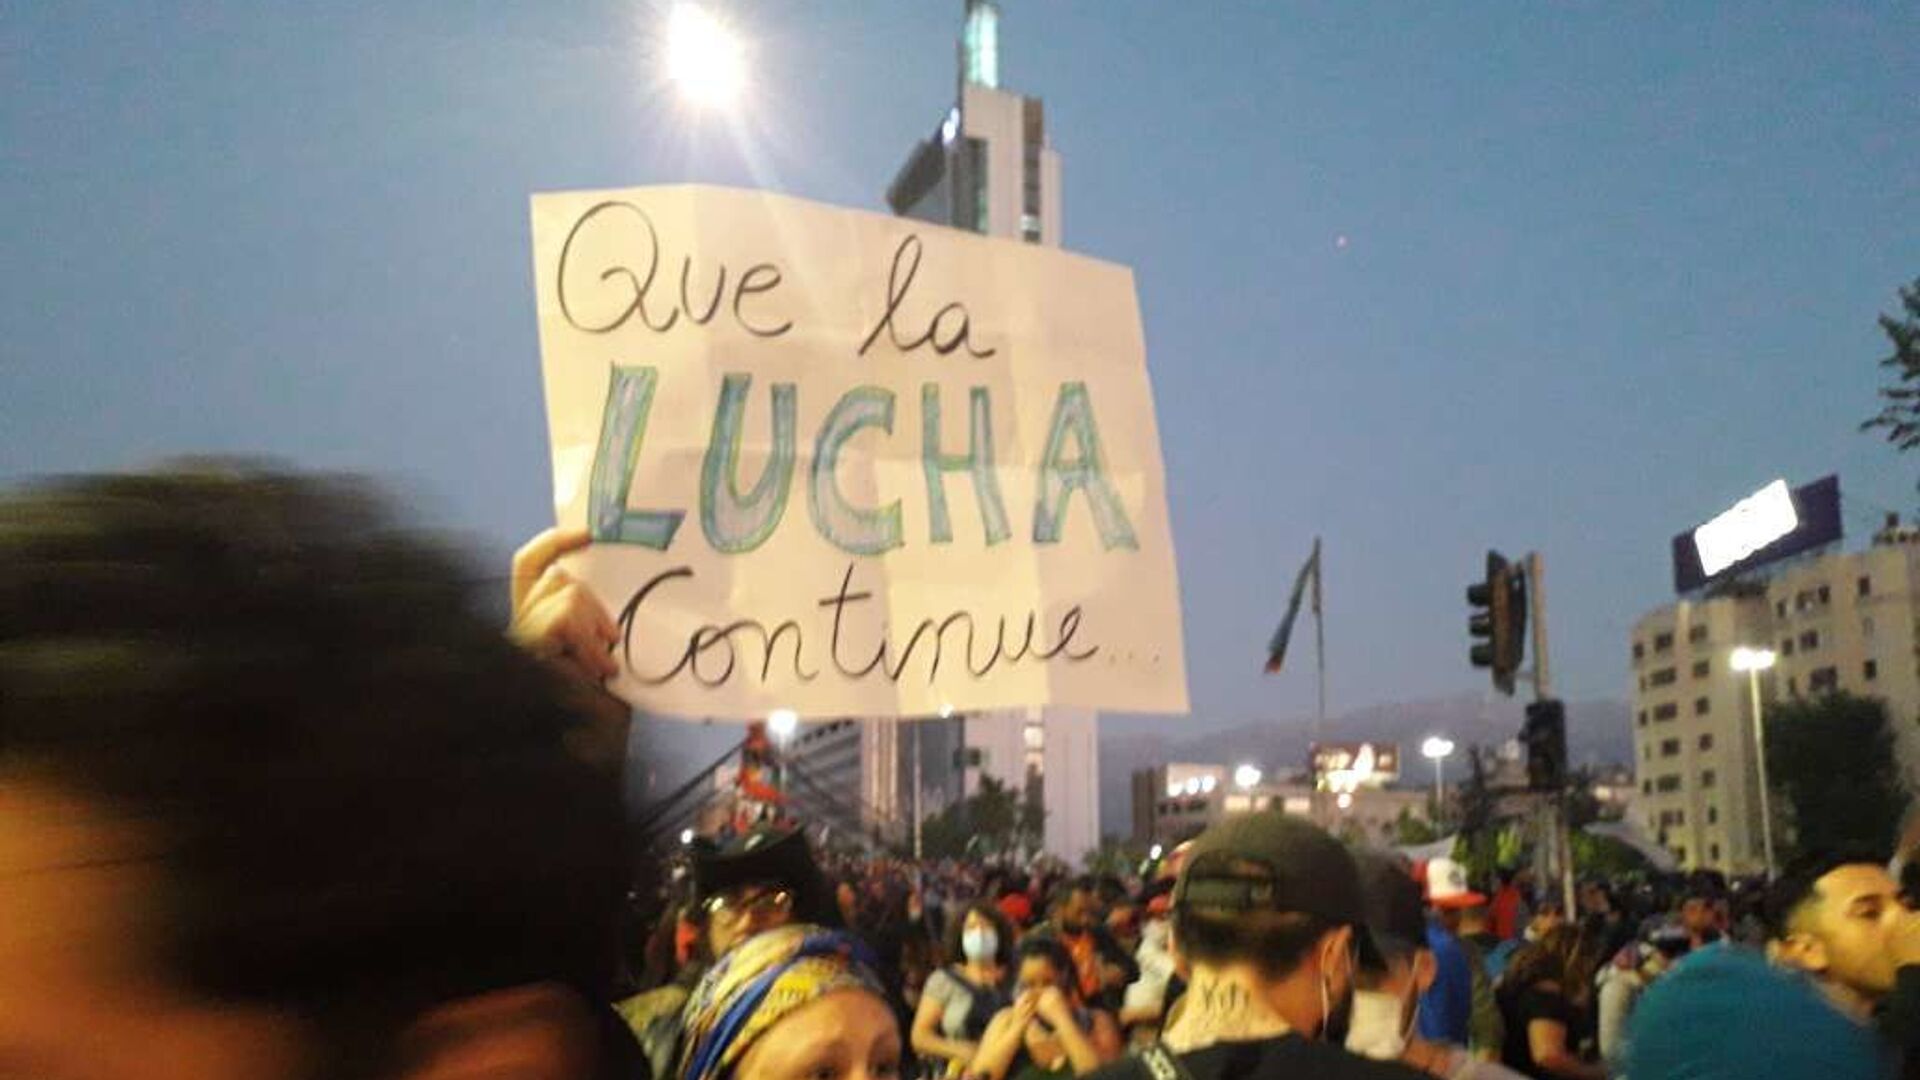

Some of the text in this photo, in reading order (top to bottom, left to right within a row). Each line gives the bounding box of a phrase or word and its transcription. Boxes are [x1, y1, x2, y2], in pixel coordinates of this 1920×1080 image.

[557, 201, 996, 358] Que la
[587, 361, 1140, 555] LUCHA
